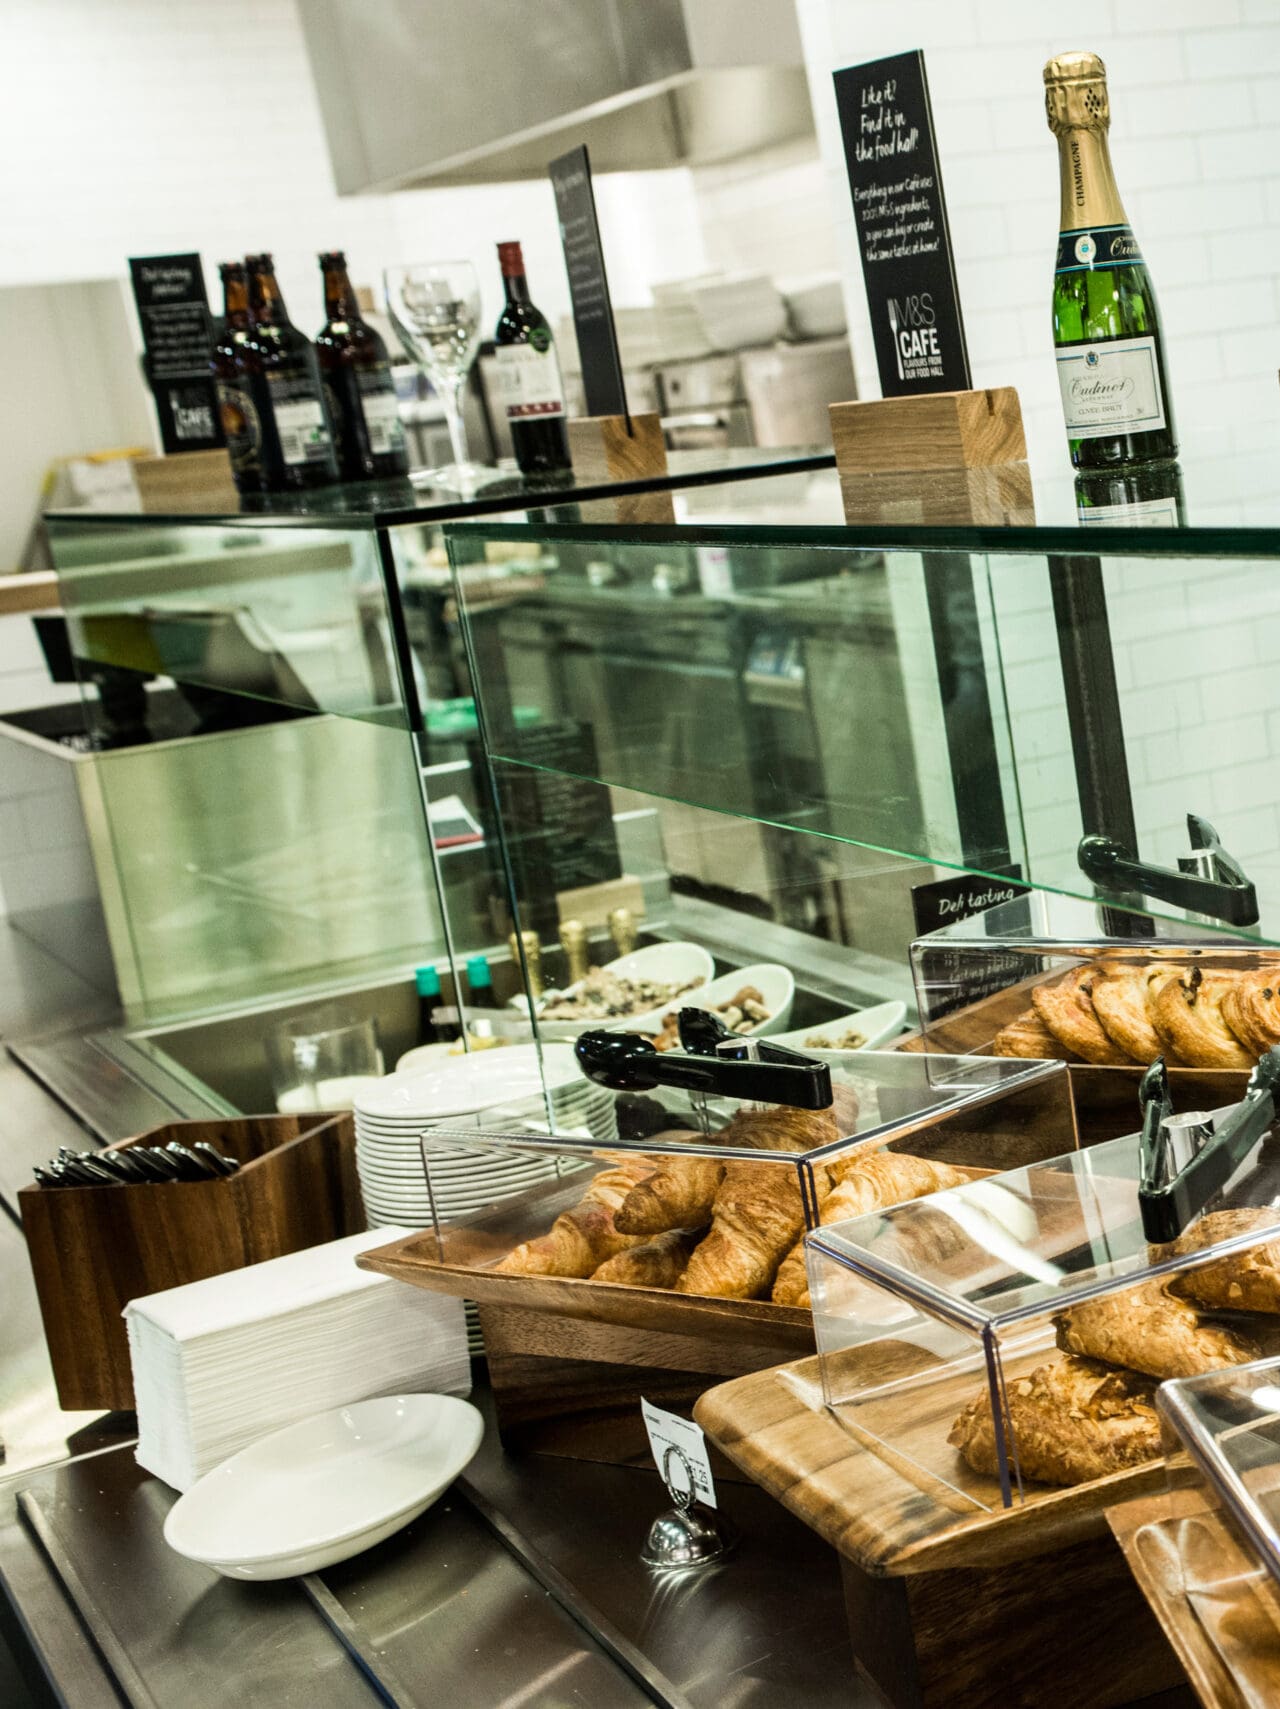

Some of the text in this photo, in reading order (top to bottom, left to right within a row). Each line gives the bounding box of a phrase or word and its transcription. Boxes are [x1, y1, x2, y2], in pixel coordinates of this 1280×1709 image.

[861, 79, 897, 108] Like it?
[861, 106, 907, 134] Find it in
[855, 137, 874, 162] the
[875, 129, 896, 162] food
[1071, 140, 1086, 207] CHAMPAGNE
[853, 182, 888, 207] Everything
[866, 247, 878, 261] the
[893, 292, 936, 328] M&S
[904, 368, 917, 380] OUR
[916, 366, 931, 378] FOOD
[1071, 377, 1126, 398] Oudinot
[938, 888, 1015, 915] Deli tasting
